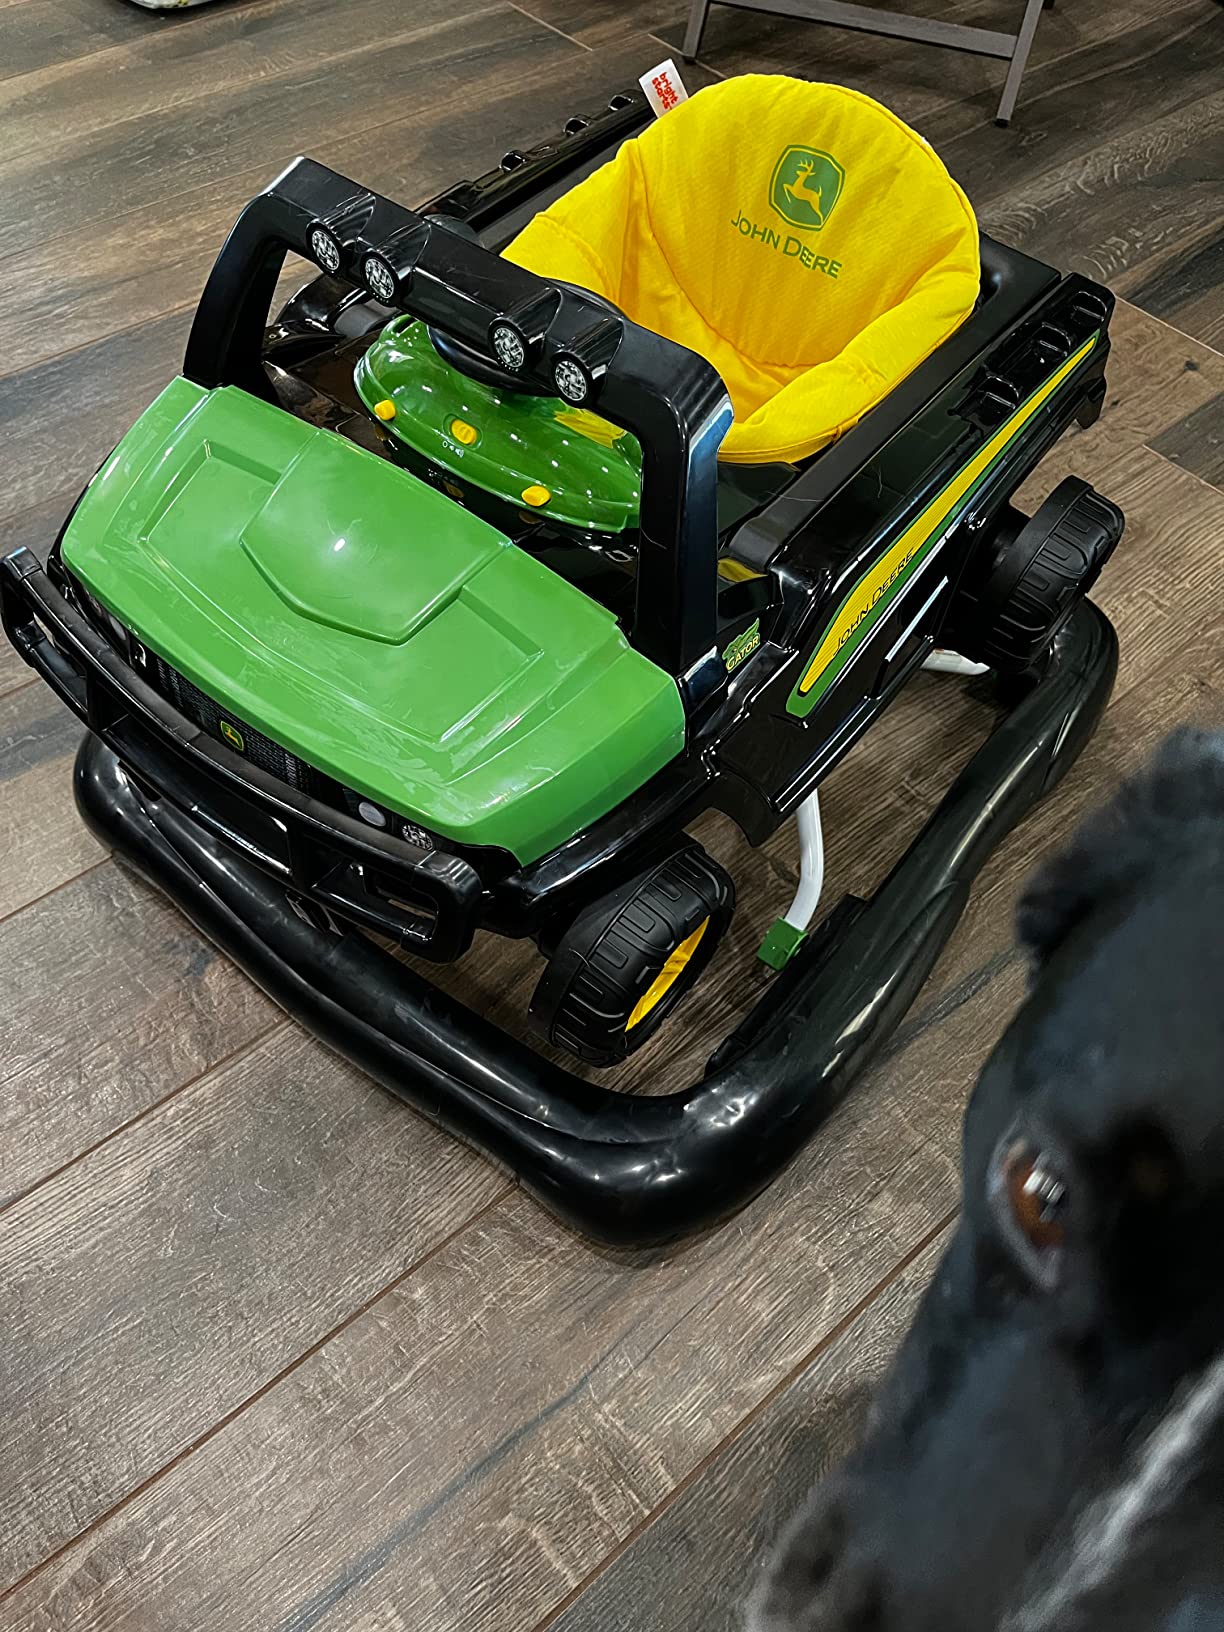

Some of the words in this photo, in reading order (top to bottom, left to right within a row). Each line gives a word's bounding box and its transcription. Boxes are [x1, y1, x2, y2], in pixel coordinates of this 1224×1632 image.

[652, 77, 670, 109] starts
[659, 72, 678, 104] bright
[731, 209, 780, 249] JOHN
[782, 236, 842, 279] DEERE
[832, 604, 869, 657] JOHN
[872, 547, 914, 605] DEERE
[727, 635, 759, 671] GATOR
